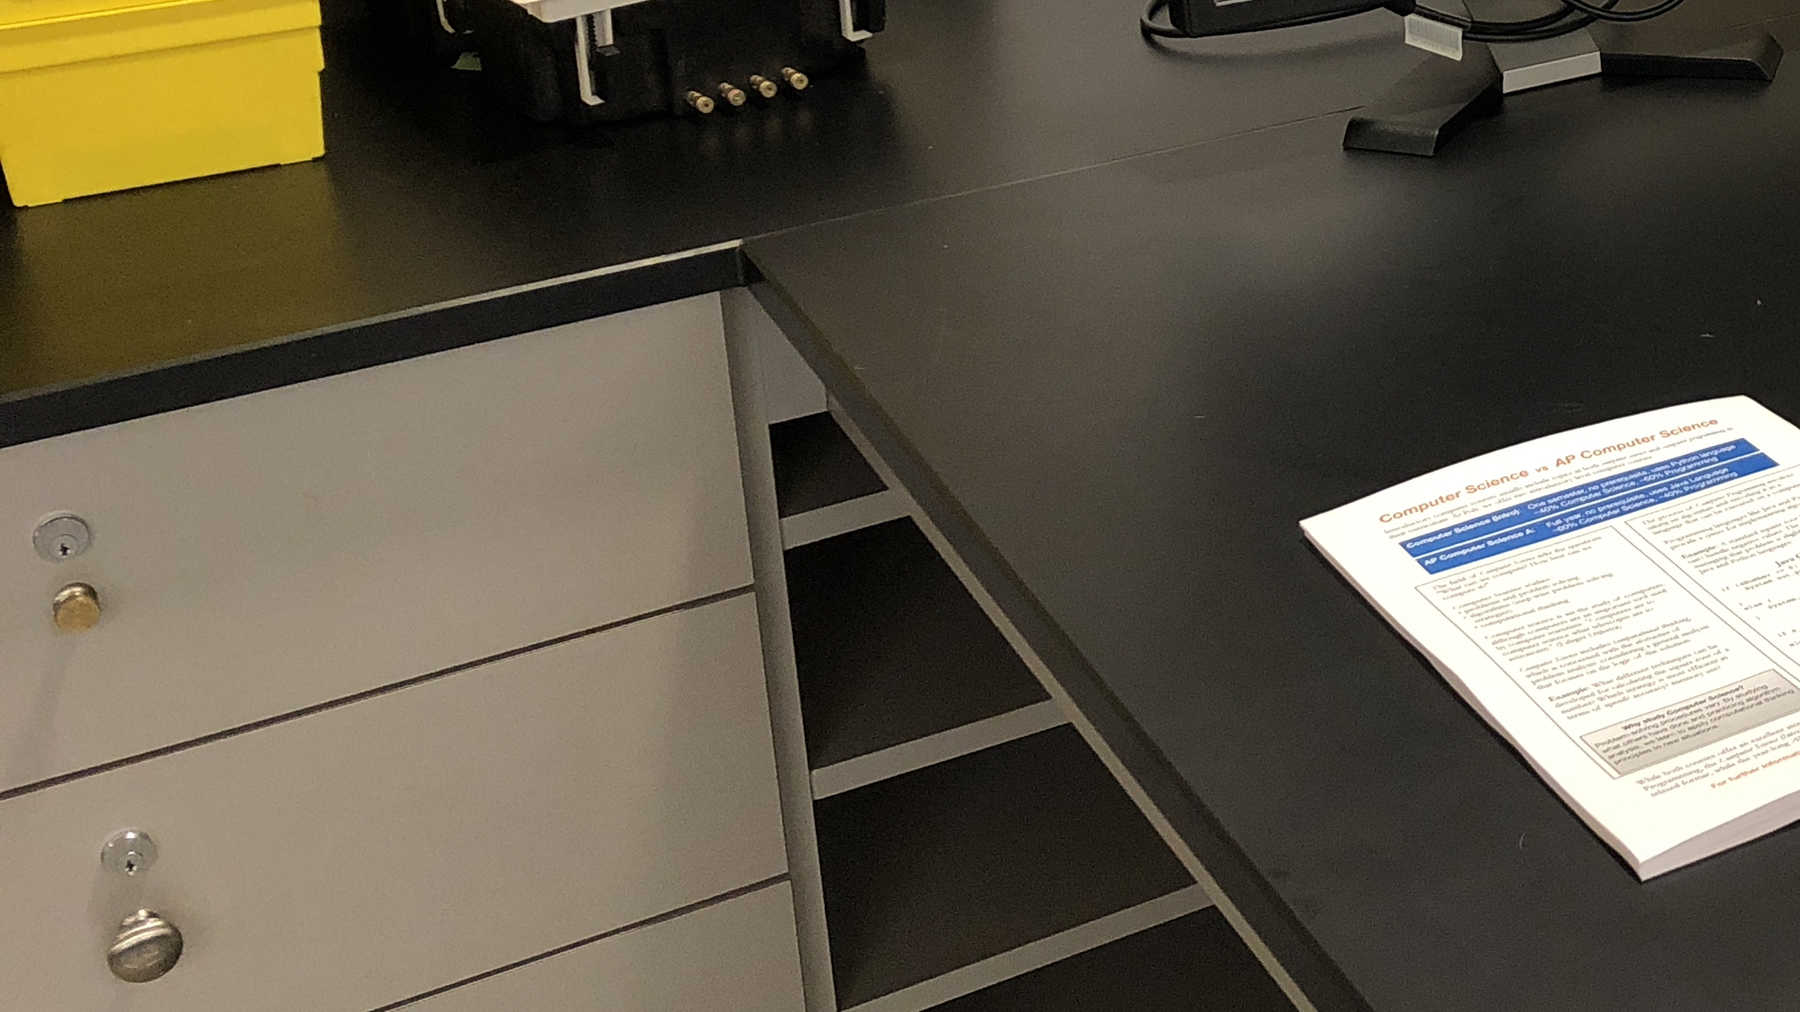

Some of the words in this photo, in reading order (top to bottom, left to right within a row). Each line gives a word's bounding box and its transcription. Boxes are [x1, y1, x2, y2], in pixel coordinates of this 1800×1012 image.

[1378, 490, 1461, 523] Computer
[1464, 470, 1529, 494] Science
[1555, 454, 1576, 468] AP
[1579, 434, 1656, 459] Computer
[1658, 419, 1719, 438] Science
